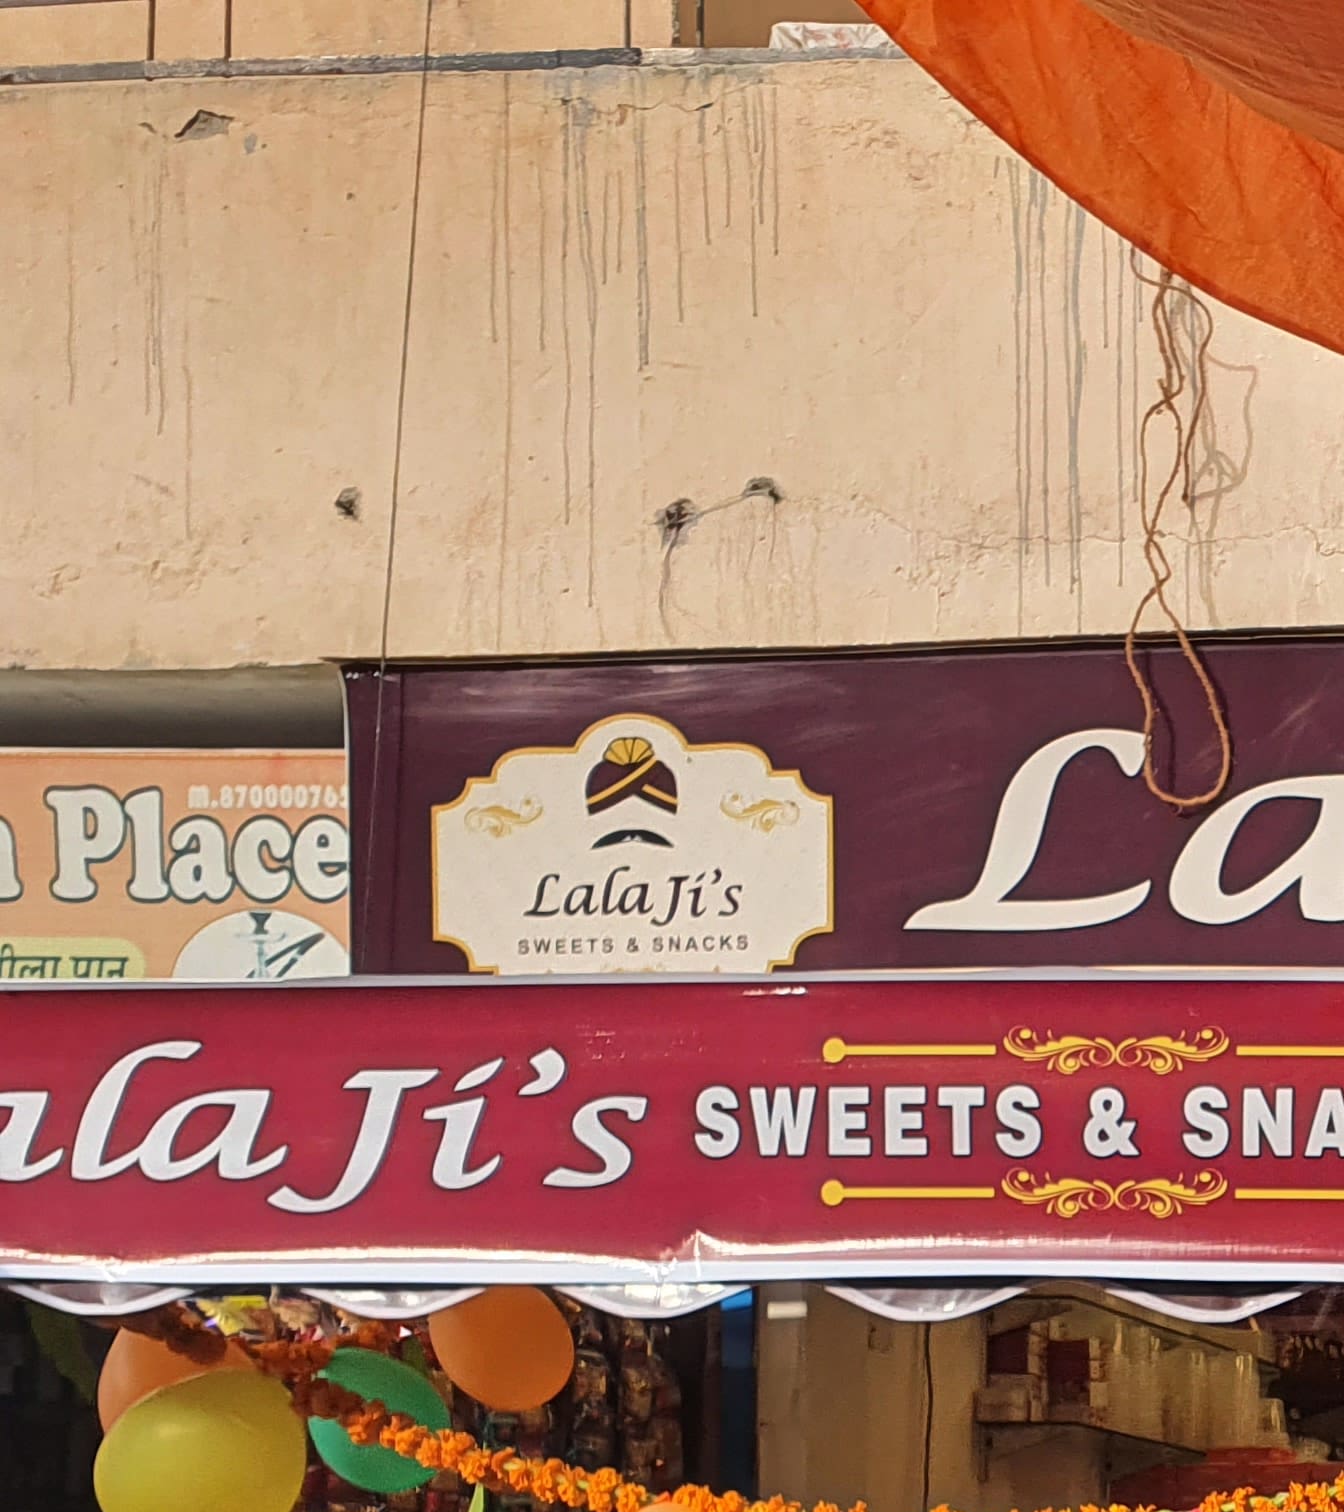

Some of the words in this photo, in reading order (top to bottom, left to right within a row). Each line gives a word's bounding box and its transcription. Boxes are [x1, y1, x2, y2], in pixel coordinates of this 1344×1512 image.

[43, 784, 348, 904] Place
[523, 865, 654, 918] Lala
[649, 866, 743, 928] Ji's
[517, 936, 615, 955] SWEETS
[626, 936, 640, 954] &
[651, 933, 750, 954] SNACKS
[0, 1040, 291, 1183] ala
[266, 1048, 648, 1214] Ji's
[693, 1083, 1043, 1161] SWEETS
[1081, 1085, 1141, 1158] &
